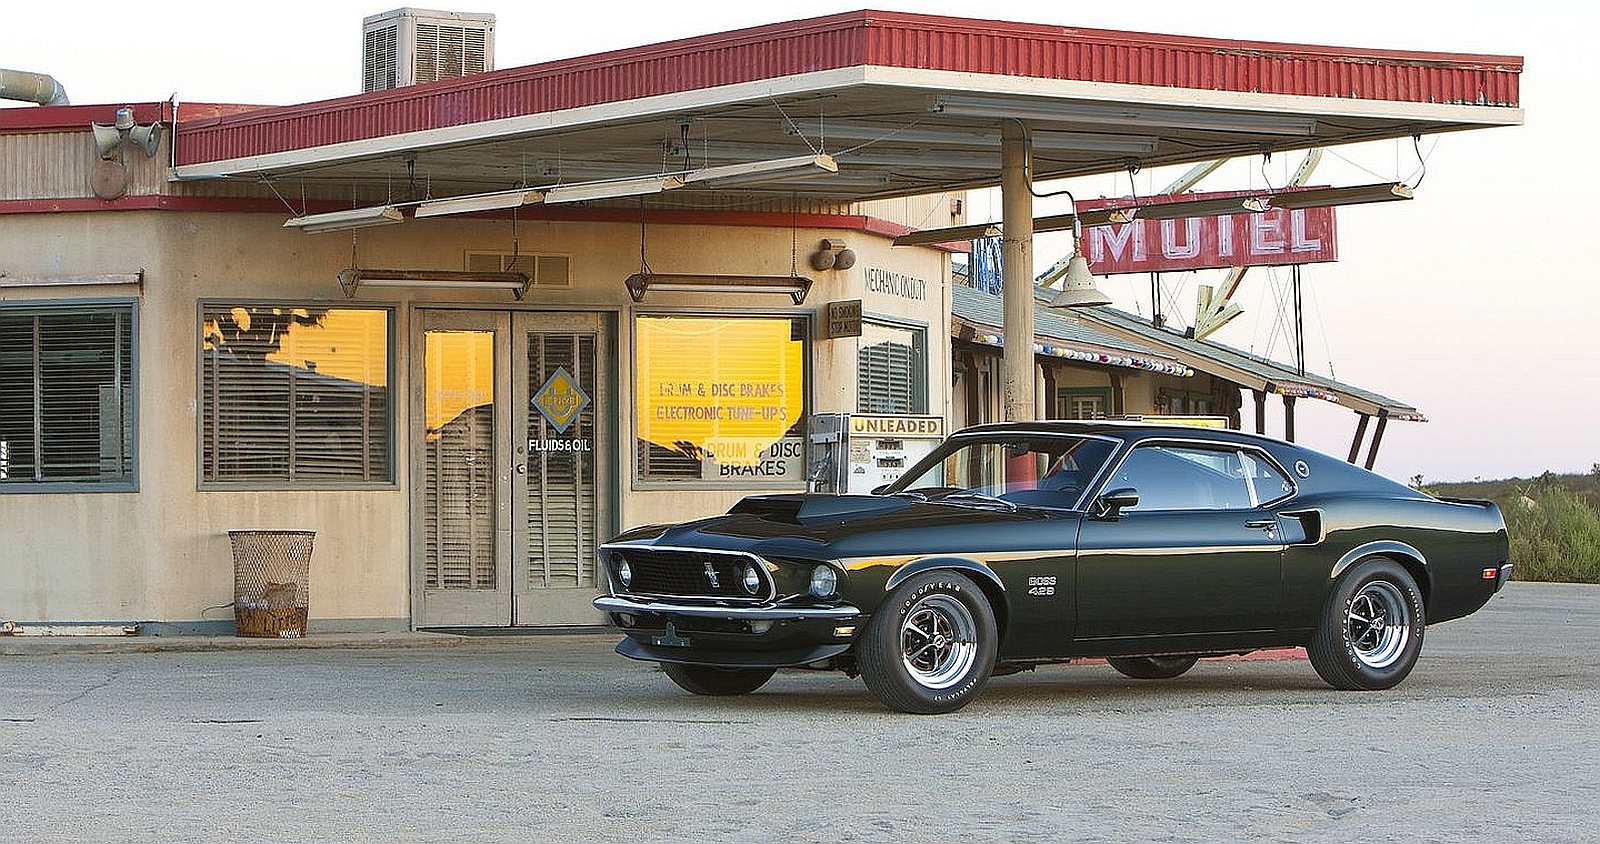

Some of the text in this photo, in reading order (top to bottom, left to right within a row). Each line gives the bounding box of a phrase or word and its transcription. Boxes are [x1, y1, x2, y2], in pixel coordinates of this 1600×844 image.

[1088, 207, 1321, 262] MOTEL
[697, 383, 706, 396] &
[711, 383, 735, 396] DISC
[740, 383, 784, 397] BRAKES
[657, 406, 787, 420] ELECTRONIC TUNE-UPS
[854, 419, 937, 433] UNLEADED
[707, 442, 801, 458] DRUM & DISC
[720, 460, 786, 476] BRAKES
[1028, 576, 1057, 586] BOSS
[900, 582, 961, 614] GOODYEAR
